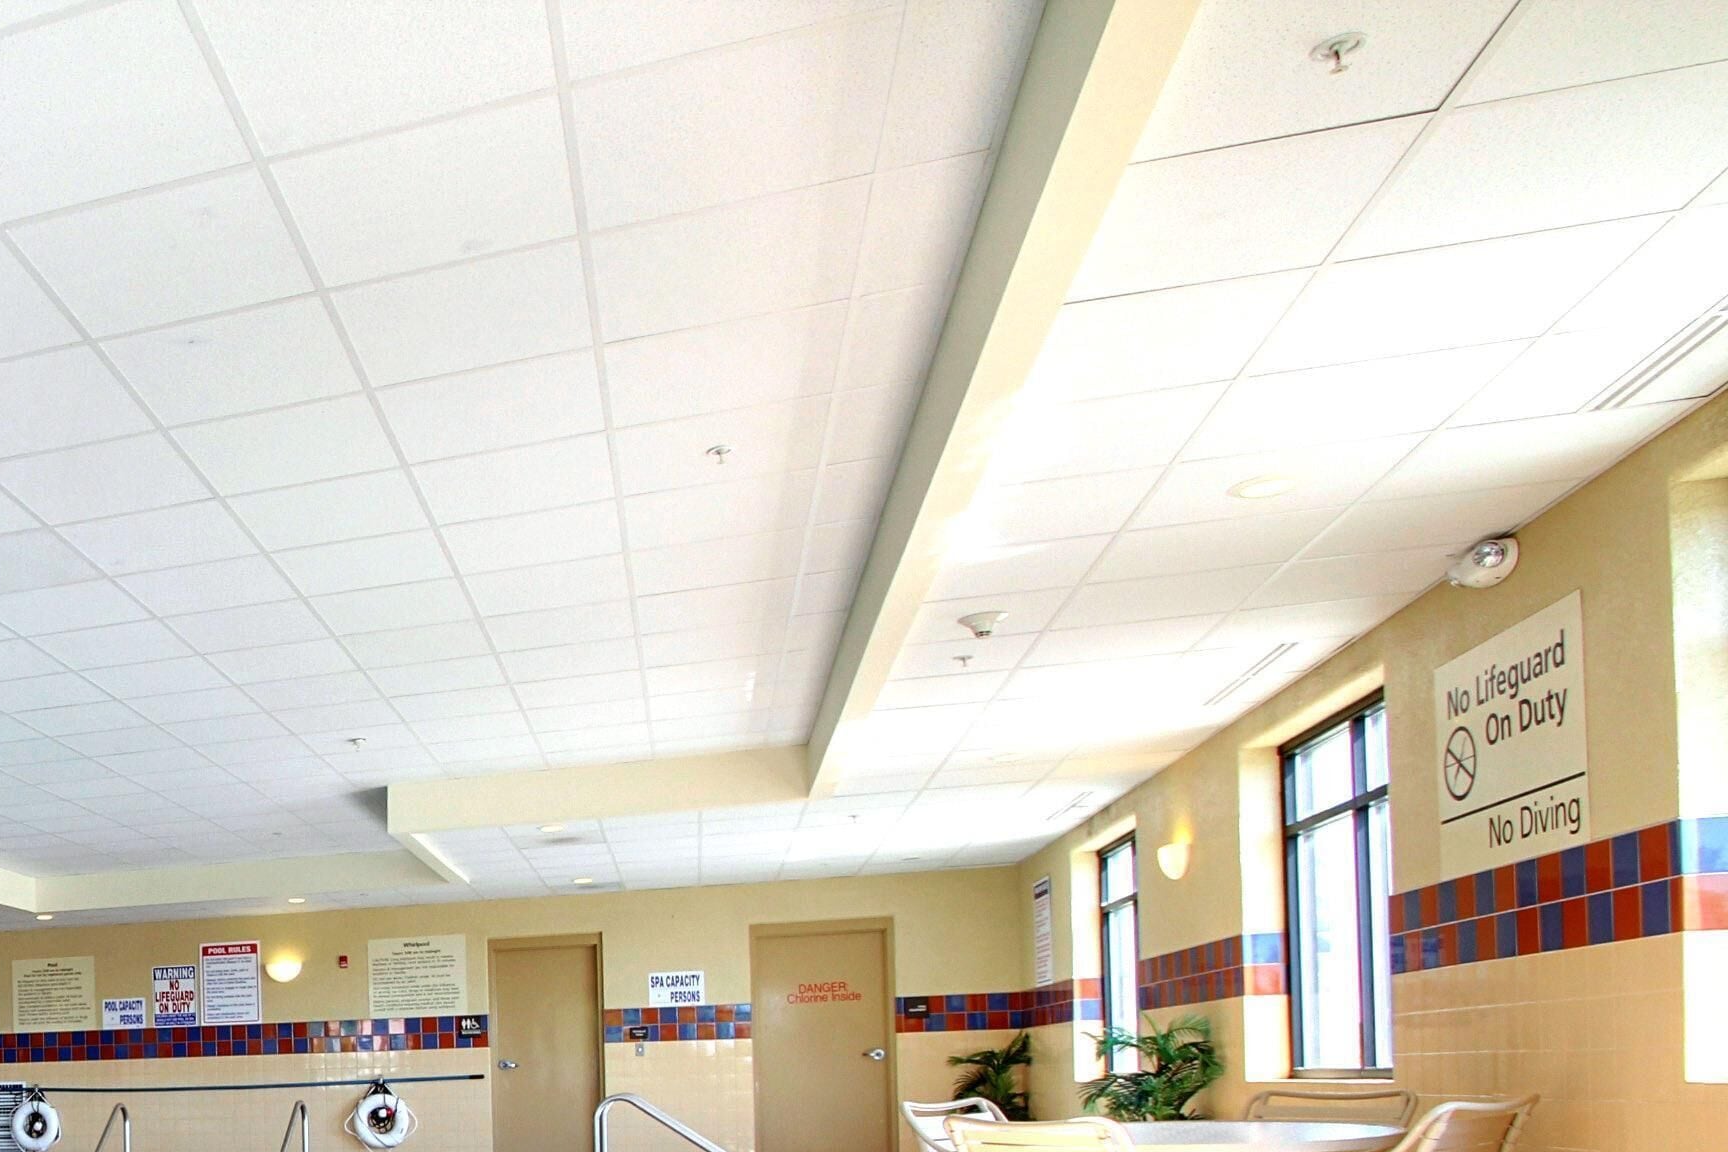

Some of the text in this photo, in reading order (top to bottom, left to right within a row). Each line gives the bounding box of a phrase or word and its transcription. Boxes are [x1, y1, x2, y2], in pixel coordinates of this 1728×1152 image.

[1446, 628, 1566, 720] No Lifeguard
[1485, 688, 1568, 746] On Duty
[1488, 796, 1581, 848] No Diving
[208, 945, 252, 955] POOL RULES
[154, 967, 194, 980] WARNING
[169, 980, 180, 990] NO
[650, 975, 701, 988] SPA CAPACITY
[155, 990, 194, 1002] LIFEGUARD
[670, 990, 701, 1003] PERSONS
[787, 991, 862, 1004] Chlorine Inside
[104, 1000, 143, 1011] POOL CAPACITY
[159, 1002, 191, 1013] ON DUTY
[119, 1014, 144, 1024] PERSONS
